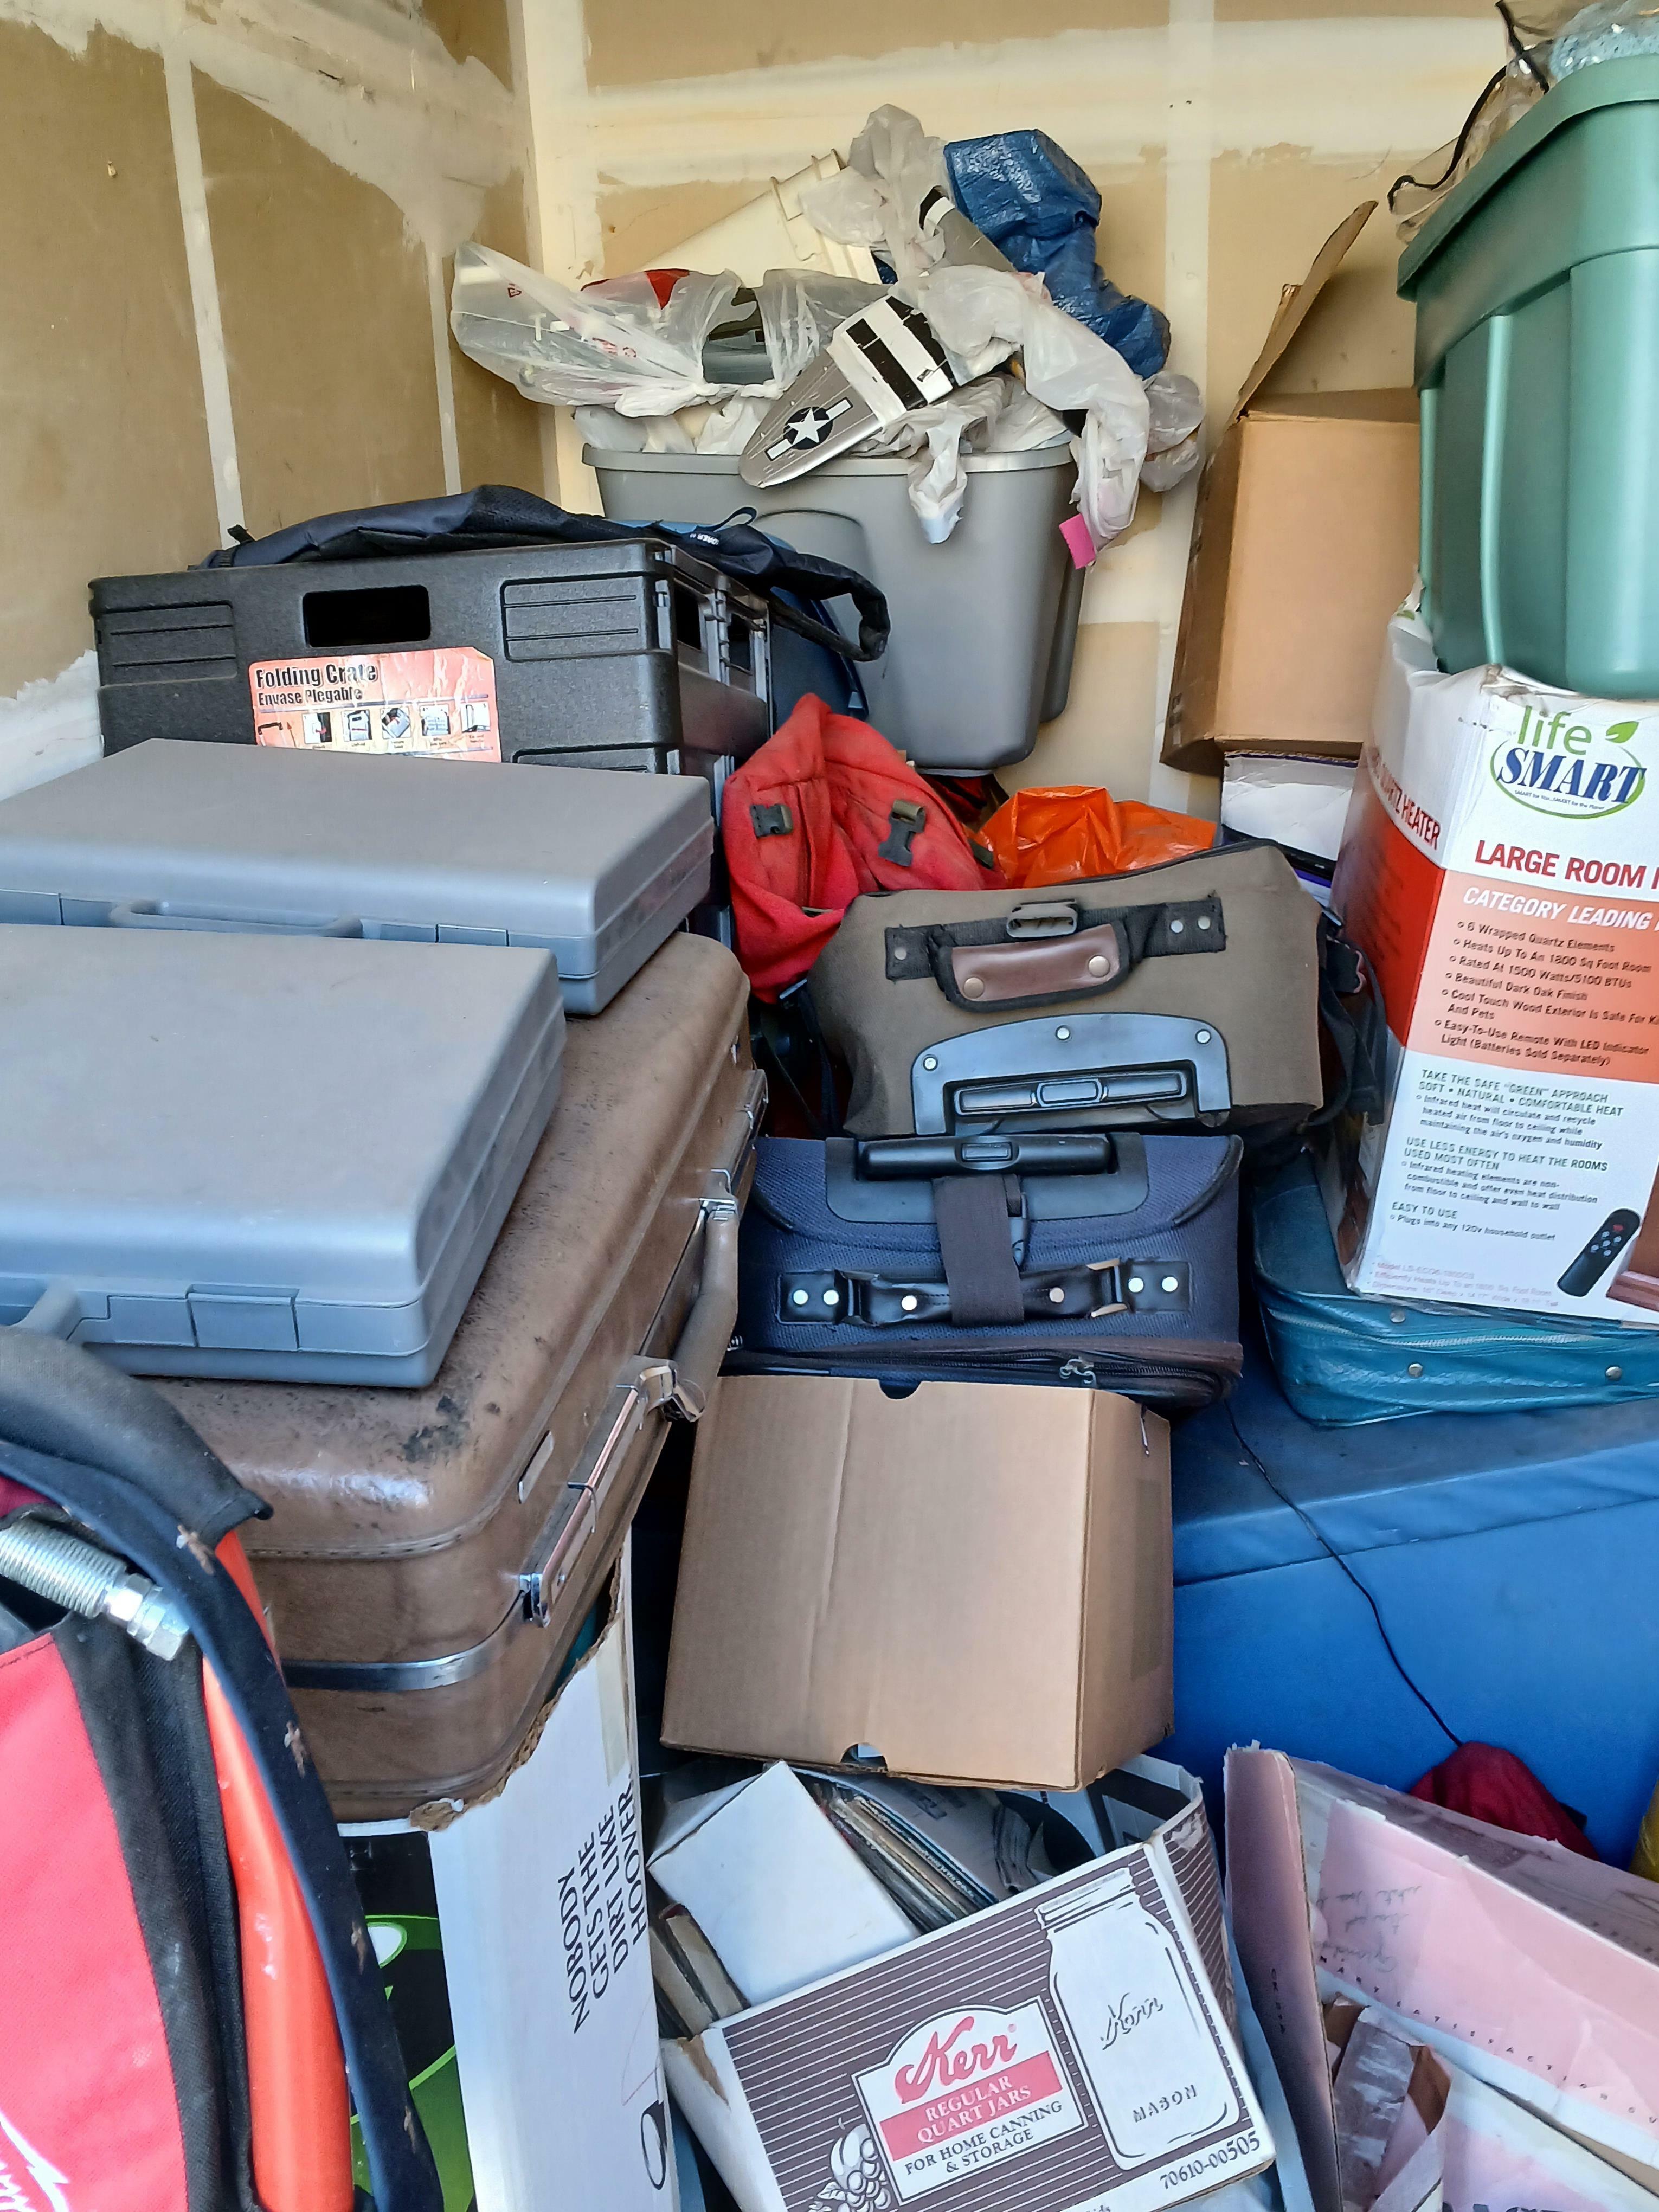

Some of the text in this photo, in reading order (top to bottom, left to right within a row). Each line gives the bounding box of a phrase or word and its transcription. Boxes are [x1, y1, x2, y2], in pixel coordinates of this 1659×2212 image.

[256, 664, 377, 687] Folding Crate
[258, 687, 363, 705] Envase Plegable
[1517, 706, 1592, 755] life
[1496, 747, 1647, 803] SMART
[1401, 794, 1441, 850] HEATER
[1475, 840, 1560, 877] LARGE
[1565, 856, 1647, 889] ROOM
[1463, 886, 1566, 920] CATEGORY
[1567, 905, 1654, 930] LEADING
[1479, 924, 1526, 941] Wrapped
[1529, 933, 1565, 947] Quartz
[1459, 956, 1490, 969] Rated
[1493, 962, 1504, 972] At
[1509, 966, 1536, 978] 1500
[1604, 978, 1631, 988] BTUs
[1463, 939, 1493, 953] Heats
[1497, 946, 1512, 957] Up
[1515, 949, 1527, 959] To
[1579, 957, 1594, 969] Sq
[1596, 959, 1619, 970] Foot
[1622, 962, 1651, 973] Room
[1455, 973, 1503, 989] Beautiful
[1506, 982, 1530, 993] Dark
[1533, 987, 1553, 997] Oak
[1448, 1004, 1495, 1019] And Pets
[1451, 989, 1475, 1001] Cool
[1478, 994, 1509, 1007] Touch
[1513, 1000, 1542, 1013] Wood
[1545, 1005, 1586, 1017] Exterior
[1589, 1009, 1599, 1019] Is
[1602, 1011, 1625, 1021] Safe
[1628, 1013, 1645, 1023] For
[1441, 1033, 1611, 1066] Light (Batteries Sold Separately)
[1444, 1020, 1507, 1039] Easy-To-Use
[1510, 1032, 1549, 1045] Remote
[1553, 1037, 1578, 1047] With
[1580, 1040, 1600, 1050] LED
[1418, 1081, 1624, 1116] SOFT NATURAL COMFORTABLE HEAT
[1422, 1069, 1448, 1082] TAKE
[1451, 1074, 1471, 1086] THE
[1475, 1078, 1501, 1091] SAFE
[1551, 1089, 1609, 1103] APPROACH
[1424, 1095, 1459, 1107] Infrared
[1563, 1116, 1596, 1125] recycle
[1404, 1148, 1500, 1170] USED MOST OFTEN
[1406, 1137, 1608, 1171] USE LESS ENERGY TO HEAT THE ROOMS
[1564, 1137, 1603, 1150] humidity
[1409, 1161, 1444, 1173] Infrared
[1392, 1201, 1458, 1219] EASY TO USE
[1548, 1192, 1598, 1203] distribution
[618, 1780, 647, 1945] HOOVER
[599, 1805, 629, 1973] DIRT LIKE
[578, 1832, 610, 1999] GETS THE
[557, 1867, 590, 2034] NOBODY
[895, 2016, 1017, 2104] Kerr
[917, 2085, 1031, 2143] QUART JARS
[925, 2075, 1013, 2122] REGULAR
[1133, 2084, 1198, 2123] MASON
[904, 2100, 1062, 2175] FOR HOME CANNING
[946, 2128, 1034, 2174] & STORAGE
[1160, 2130, 1260, 2189] 70610-00505
